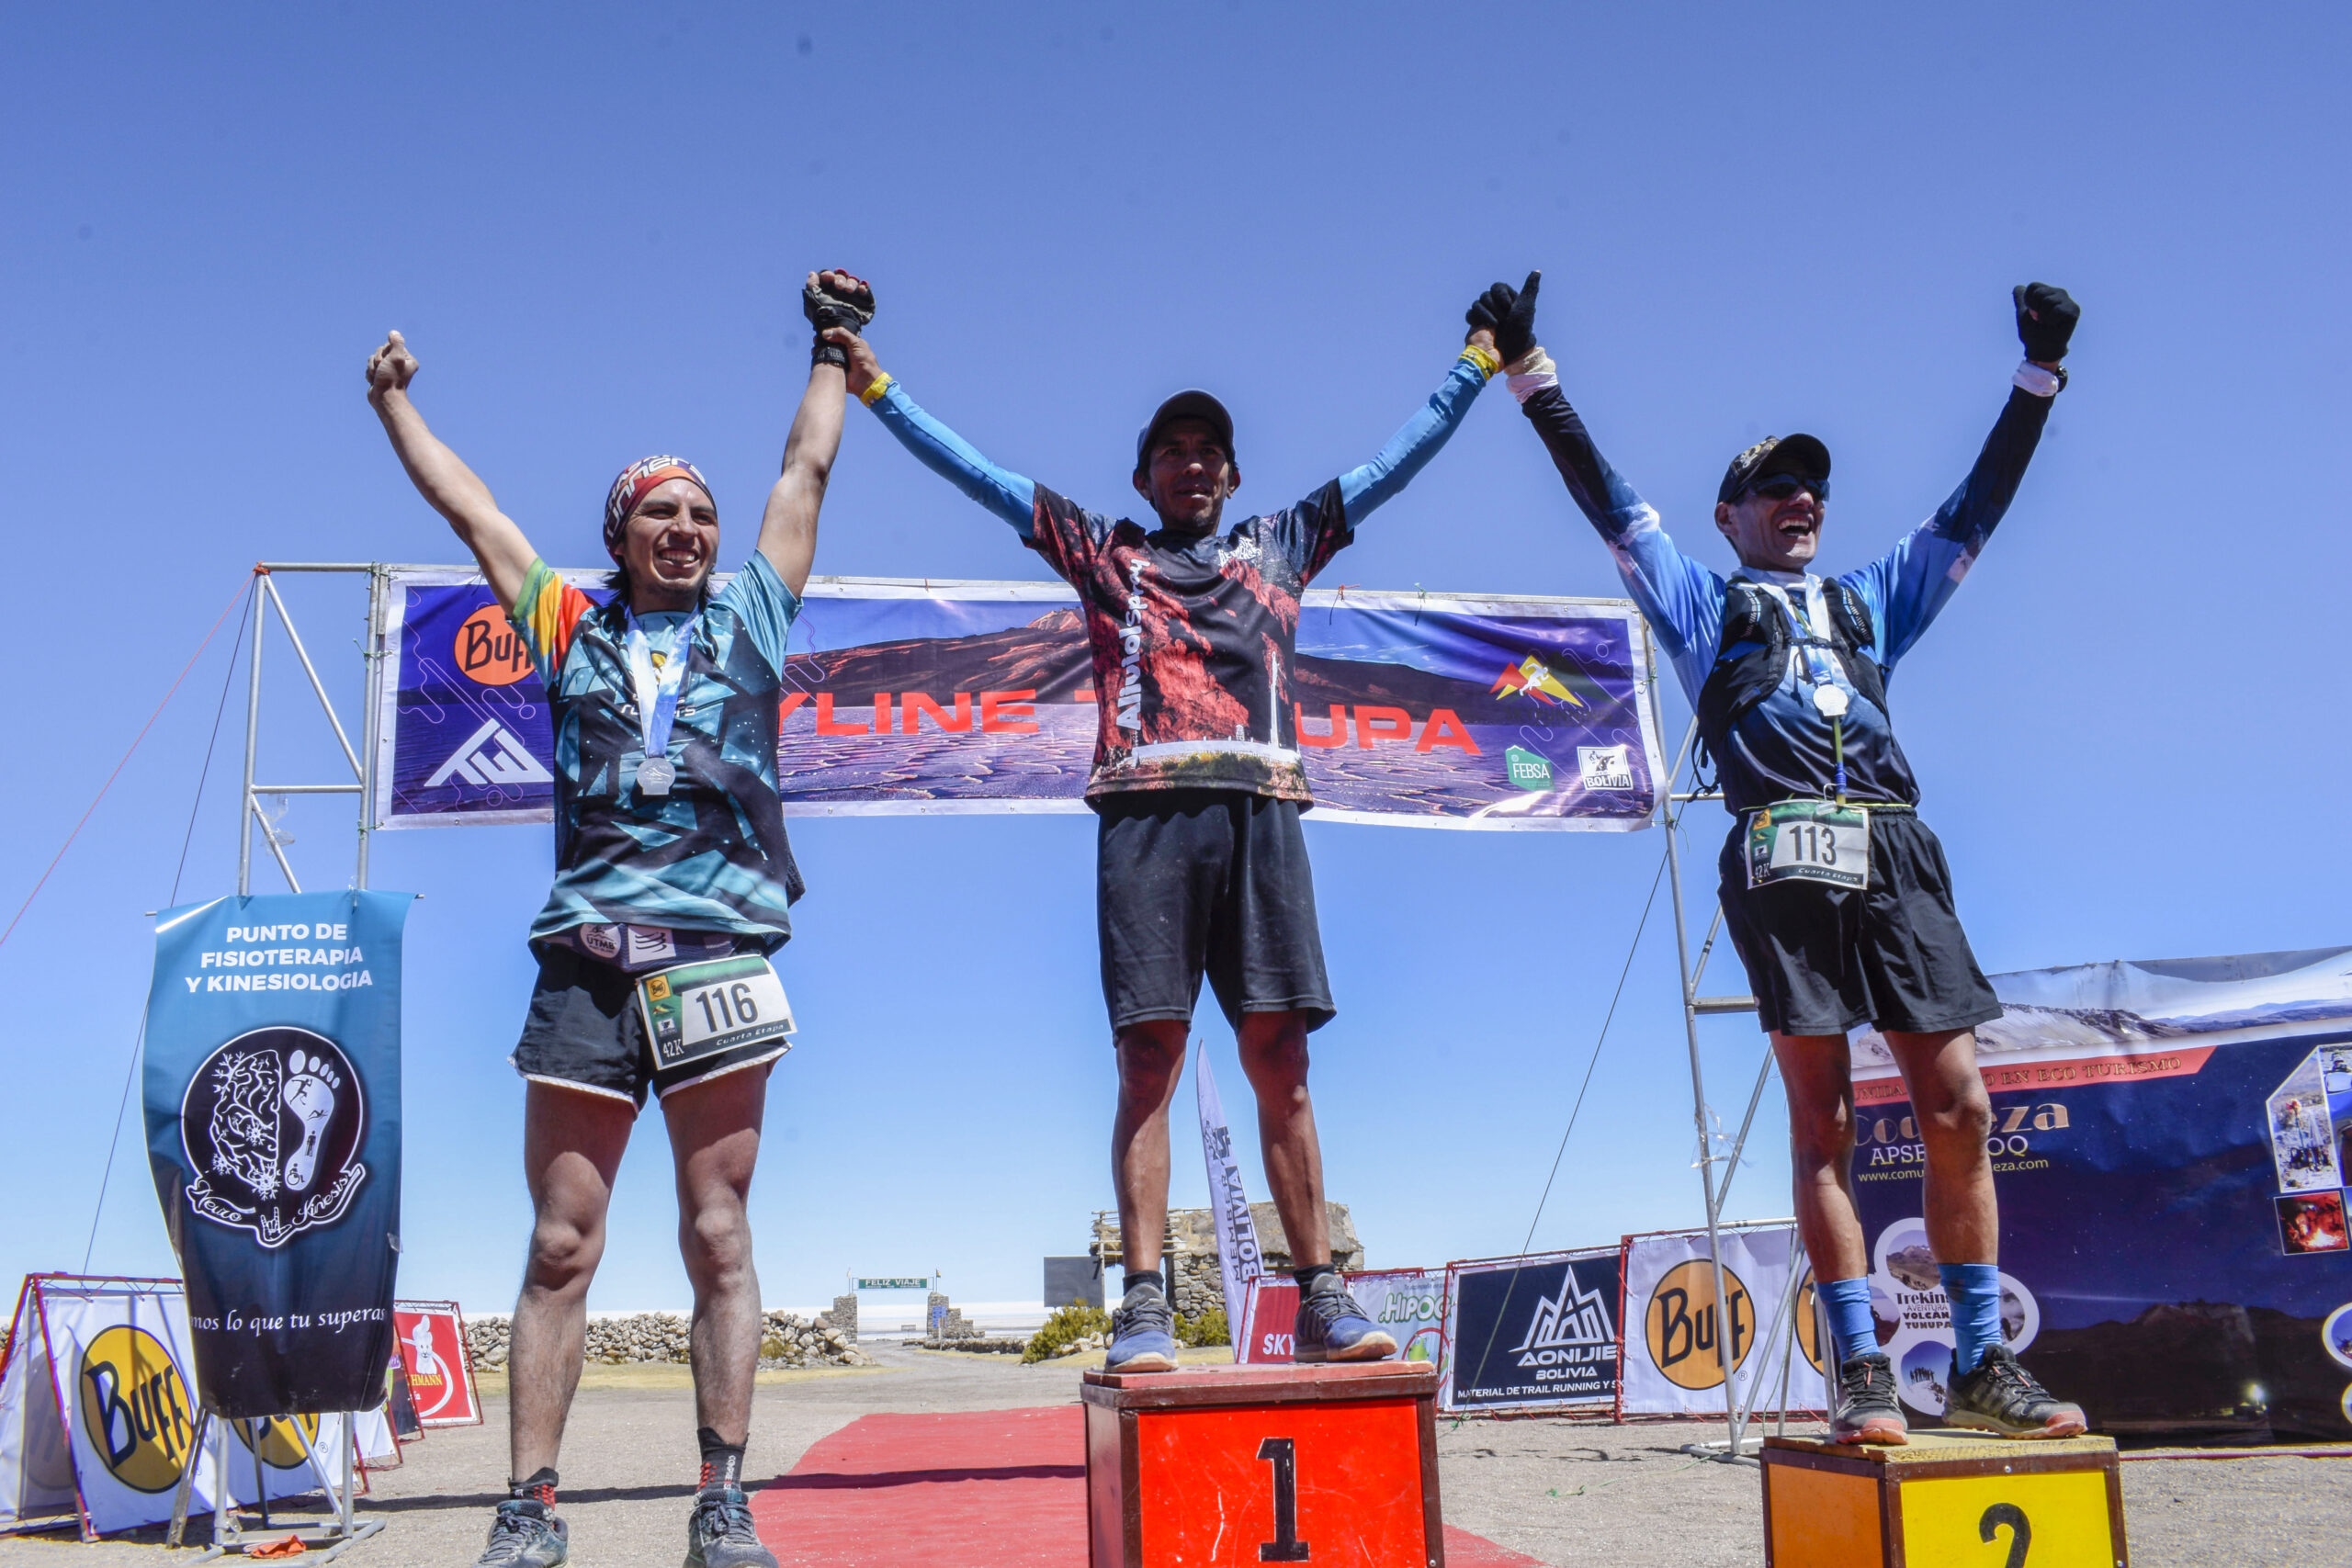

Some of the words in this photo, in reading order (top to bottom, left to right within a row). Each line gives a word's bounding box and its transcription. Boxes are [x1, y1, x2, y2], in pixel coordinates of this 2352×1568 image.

[778, 689, 1038, 736] YLINE
[1295, 703, 1481, 755] UPA
[1512, 763, 1551, 779] FEBSA
[1587, 774, 1630, 787] BOLIVIA
[1789, 825, 1837, 866] 113
[226, 924, 310, 942] PUNTO
[315, 923, 347, 940] DE
[587, 936, 616, 950] UTMB
[200, 946, 364, 968] FISIOTERAPIA
[185, 976, 202, 993] Y
[207, 970, 373, 991] KINESIOLOGIA
[695, 983, 759, 1032] 116
[717, 1032, 752, 1046] Cuarta
[755, 1024, 784, 1035] Etapa
[662, 1039, 684, 1058] 42K
[2001, 1070, 2030, 1085] EN
[2038, 1066, 2076, 1082] ECO
[2082, 1057, 2181, 1078] TURISMO
[1221, 1174, 1240, 1281] MEMBER
[1227, 1168, 1261, 1283] BOLIVIA
[1385, 1292, 1452, 1323] HIPOG
[226, 1310, 243, 1330] lo
[250, 1316, 283, 1337] que
[290, 1314, 311, 1329] tu
[318, 1308, 386, 1334] superas
[1905, 1321, 1953, 1329] TUNUPA
[1262, 1334, 1295, 1355] SKY
[1517, 1345, 1617, 1367] AONIJIE
[410, 1374, 443, 1386] HMANN
[1536, 1366, 1598, 1381] BOLIVIA
[1458, 1388, 1505, 1399] MATERIAL
[1506, 1386, 1520, 1396] DE
[1521, 1384, 1551, 1394] TRAIL
[1553, 1382, 1600, 1393] RUNNING
[1602, 1380, 1610, 1389] Y
[1257, 1437, 1310, 1562] 1
[1978, 1502, 2033, 1568] 2
